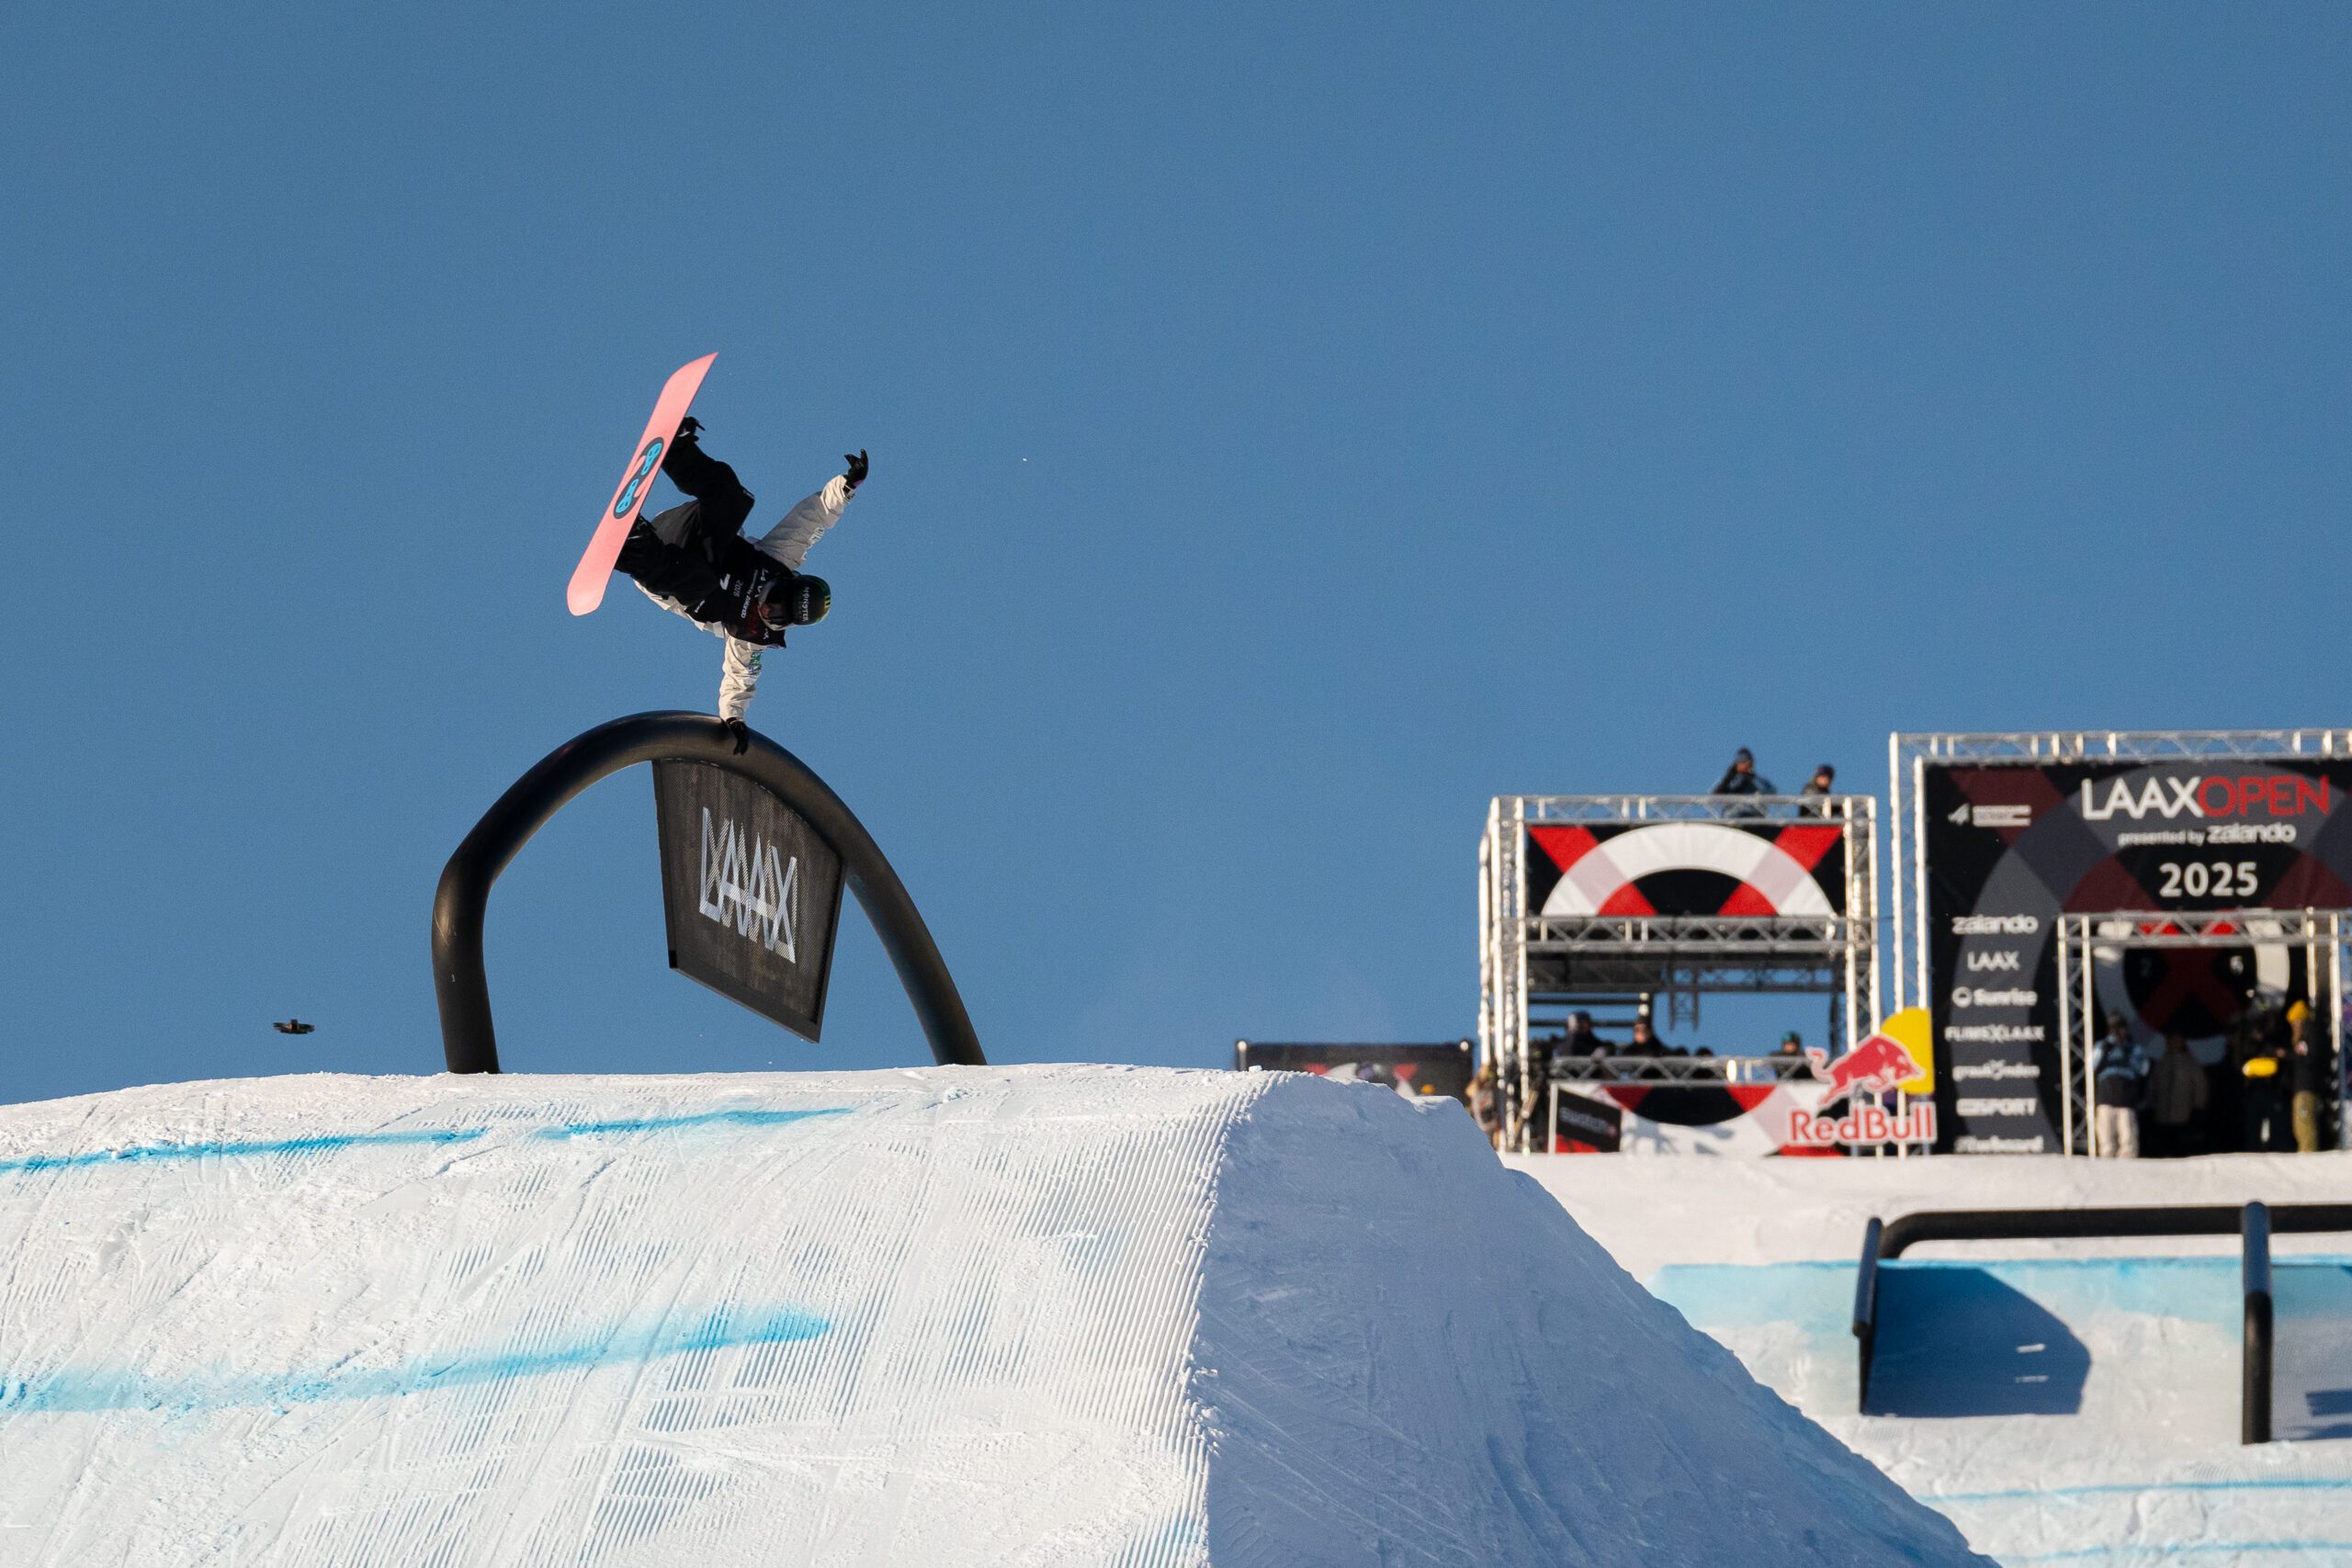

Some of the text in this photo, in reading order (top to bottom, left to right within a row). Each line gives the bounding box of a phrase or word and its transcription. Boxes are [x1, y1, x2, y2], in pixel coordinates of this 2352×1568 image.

[2188, 830, 2206, 847] by
[2207, 822, 2296, 844] zalando
[2159, 862, 2259, 897] 2025
[1951, 914, 2039, 934] zalando
[1967, 951, 2021, 972] LAAX
